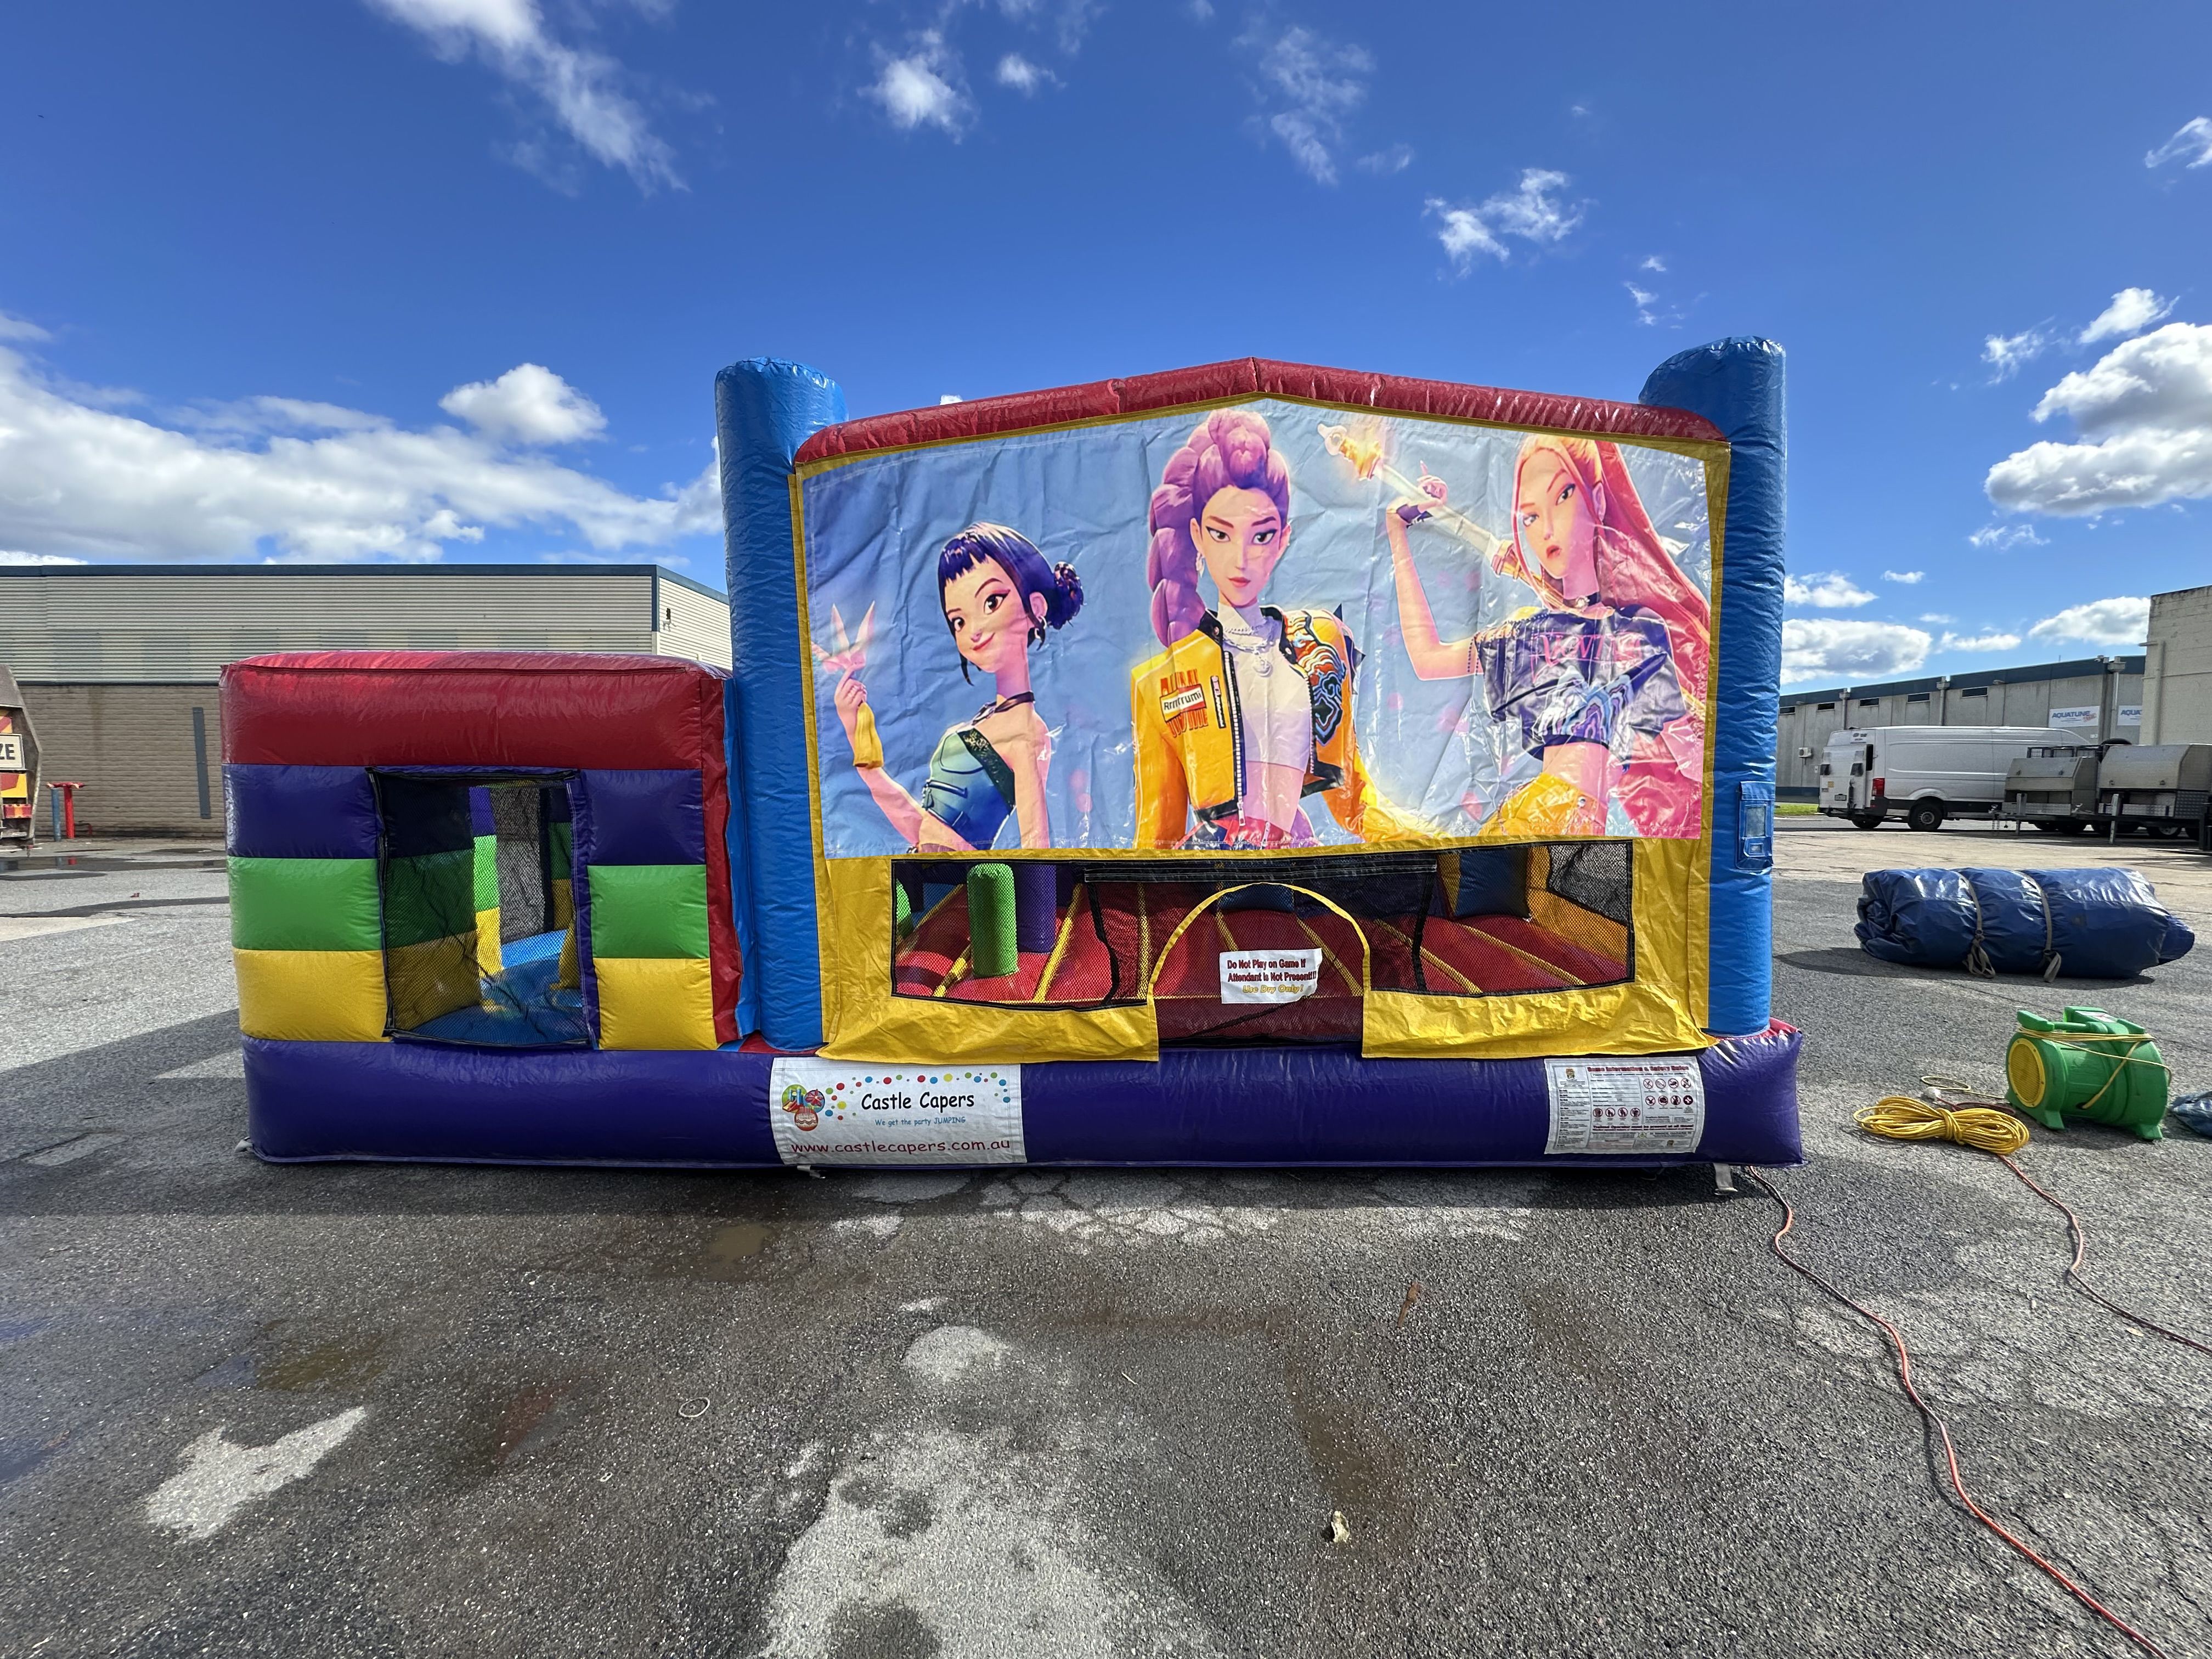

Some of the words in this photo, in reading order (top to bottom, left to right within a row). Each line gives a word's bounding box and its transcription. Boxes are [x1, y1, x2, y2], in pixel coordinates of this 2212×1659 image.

[1227, 960, 1237, 969] Do
[1239, 959, 1251, 969] Not
[1252, 959, 1267, 970] Play
[1279, 958, 1299, 968] Game
[1228, 972, 1262, 982] Attendant
[1270, 972, 1283, 981] Not
[1242, 985, 1259, 994] Use
[1260, 984, 1276, 994] Dry
[861, 1092, 912, 1110] Castle
[919, 1091, 975, 1113] Capers
[914, 1118, 931, 1127] party
[791, 1139, 1010, 1155] www.castlecapers.com.au
